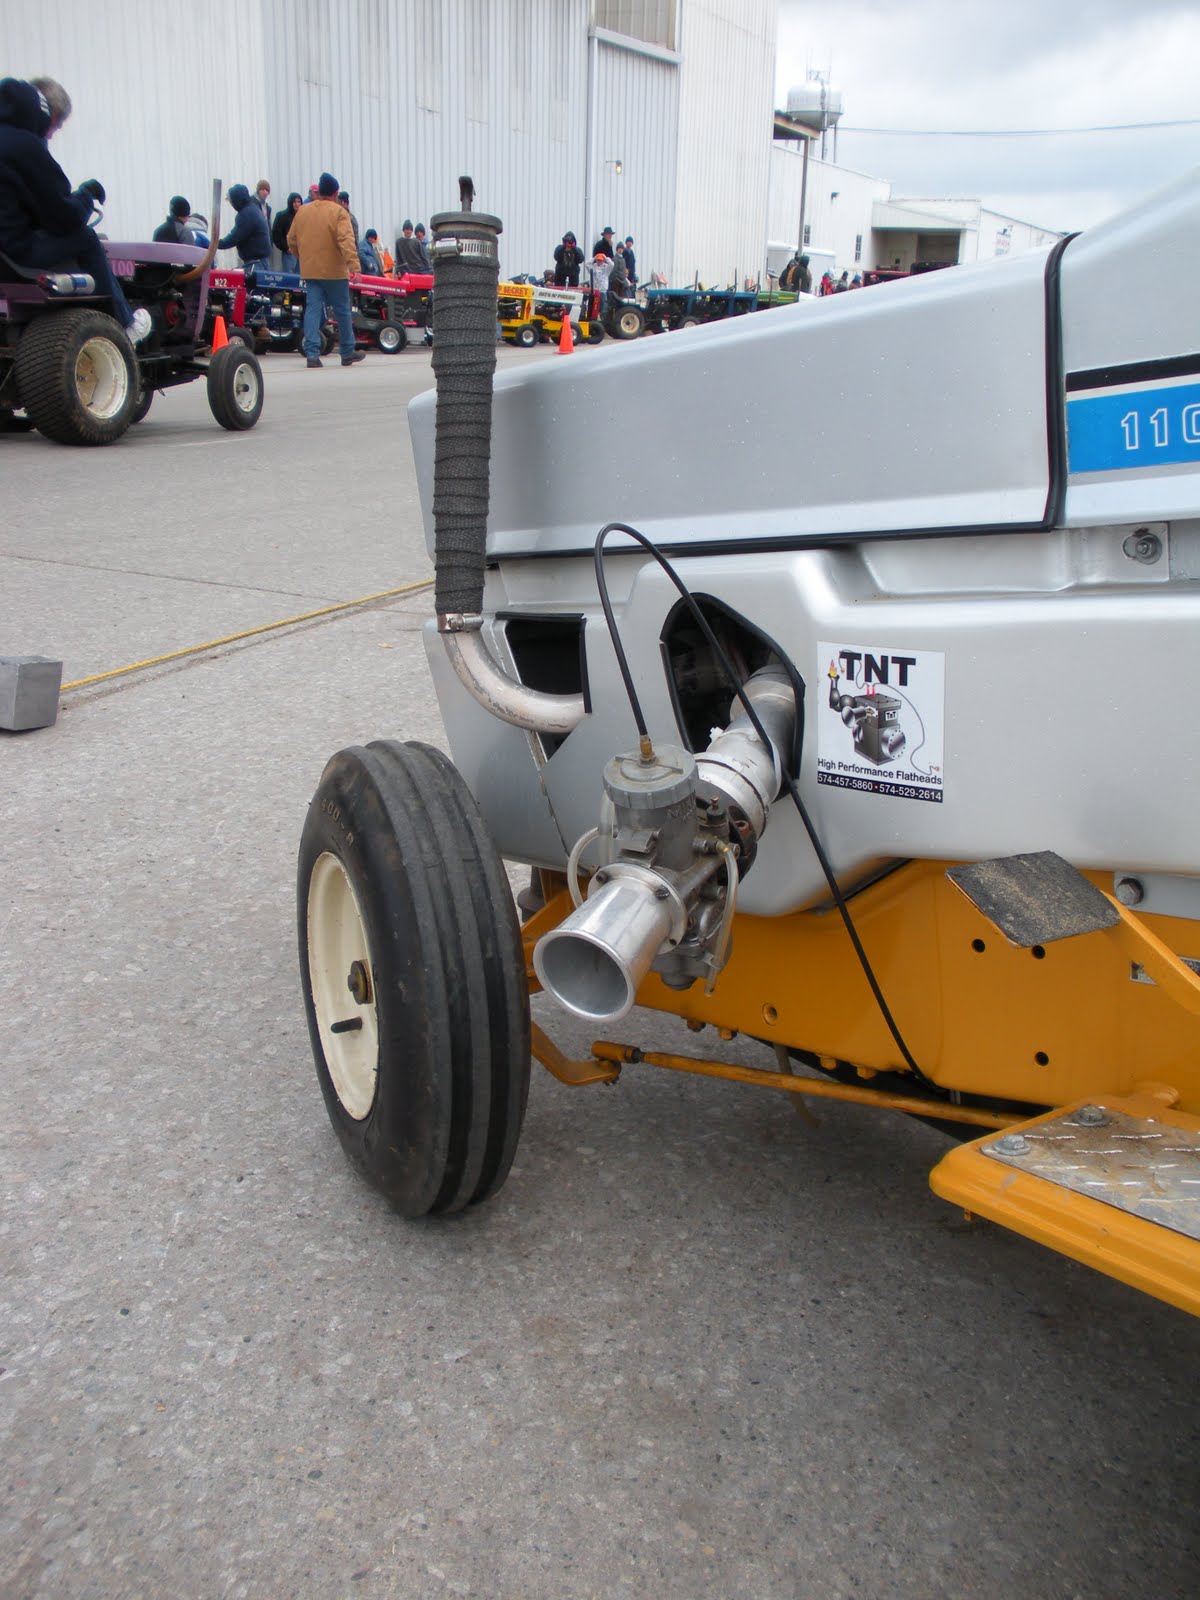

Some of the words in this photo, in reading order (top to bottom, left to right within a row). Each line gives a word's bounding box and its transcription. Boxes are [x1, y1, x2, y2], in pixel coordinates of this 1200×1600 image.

[504, 286, 529, 296] SECRET
[839, 651, 916, 686] TNT
[818, 758, 836, 770] High
[838, 762, 894, 779] Performance
[896, 771, 942, 785] Flatheads
[818, 773, 873, 791] 574-457-5860
[879, 784, 942, 801] 574-529-2614
